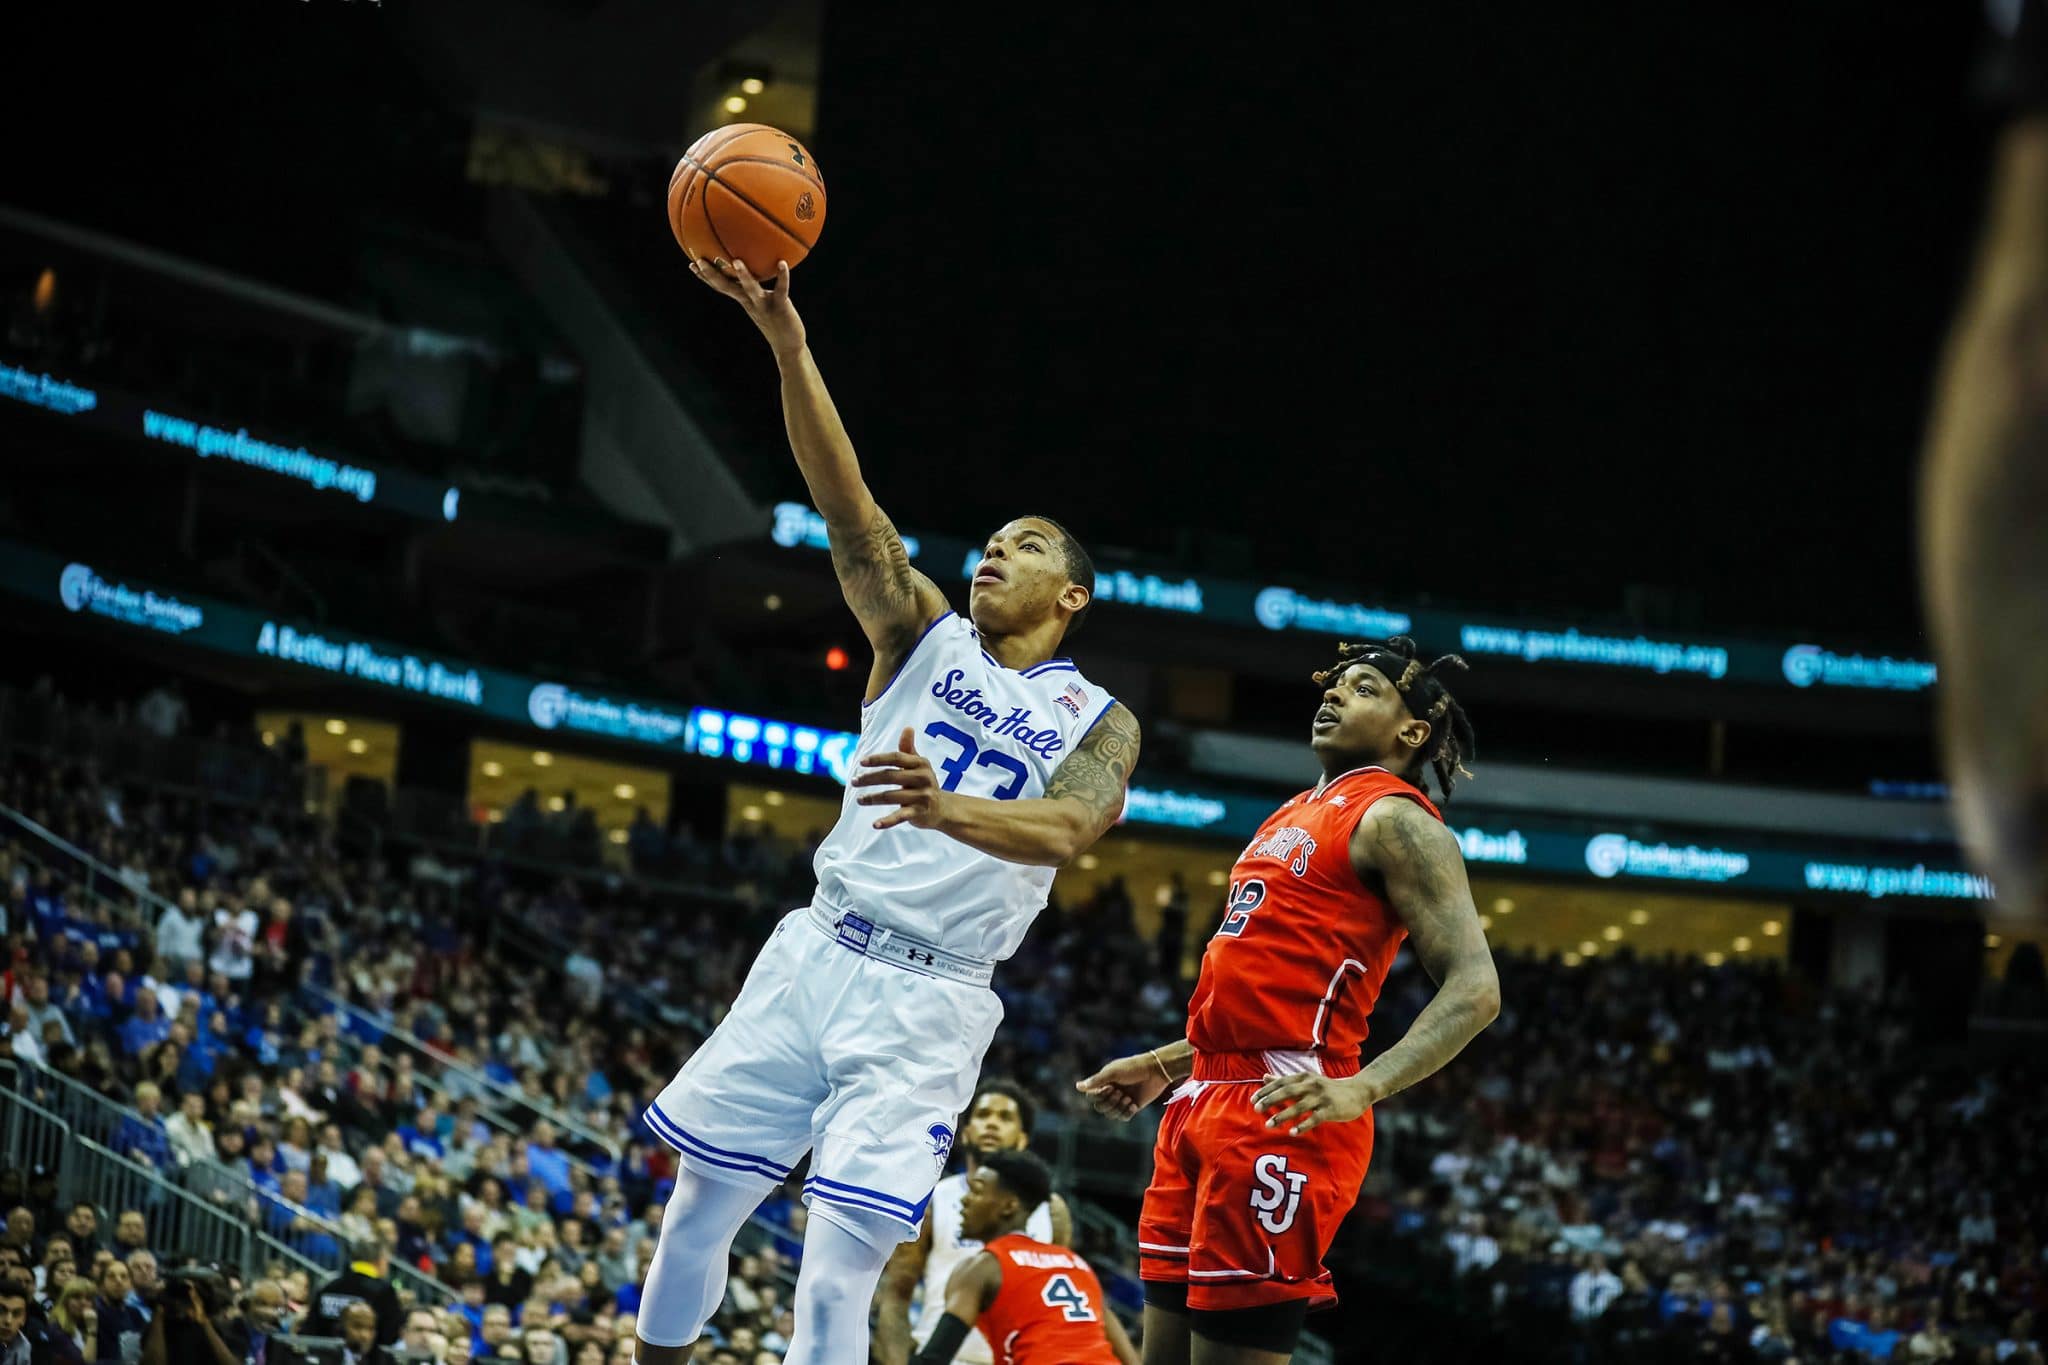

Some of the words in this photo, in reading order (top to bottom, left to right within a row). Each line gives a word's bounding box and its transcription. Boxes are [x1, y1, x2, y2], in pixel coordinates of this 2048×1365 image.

[1142, 575, 1203, 613] Bank
[256, 621, 277, 655] A
[279, 625, 343, 672] Better
[345, 642, 401, 686] Place
[403, 655, 426, 692] To
[427, 662, 482, 706] Bank
[932, 669, 998, 728] Seton
[993, 706, 1063, 760] Hall
[1463, 828, 1527, 864] Bank
[1041, 1273, 1098, 1323] 4
